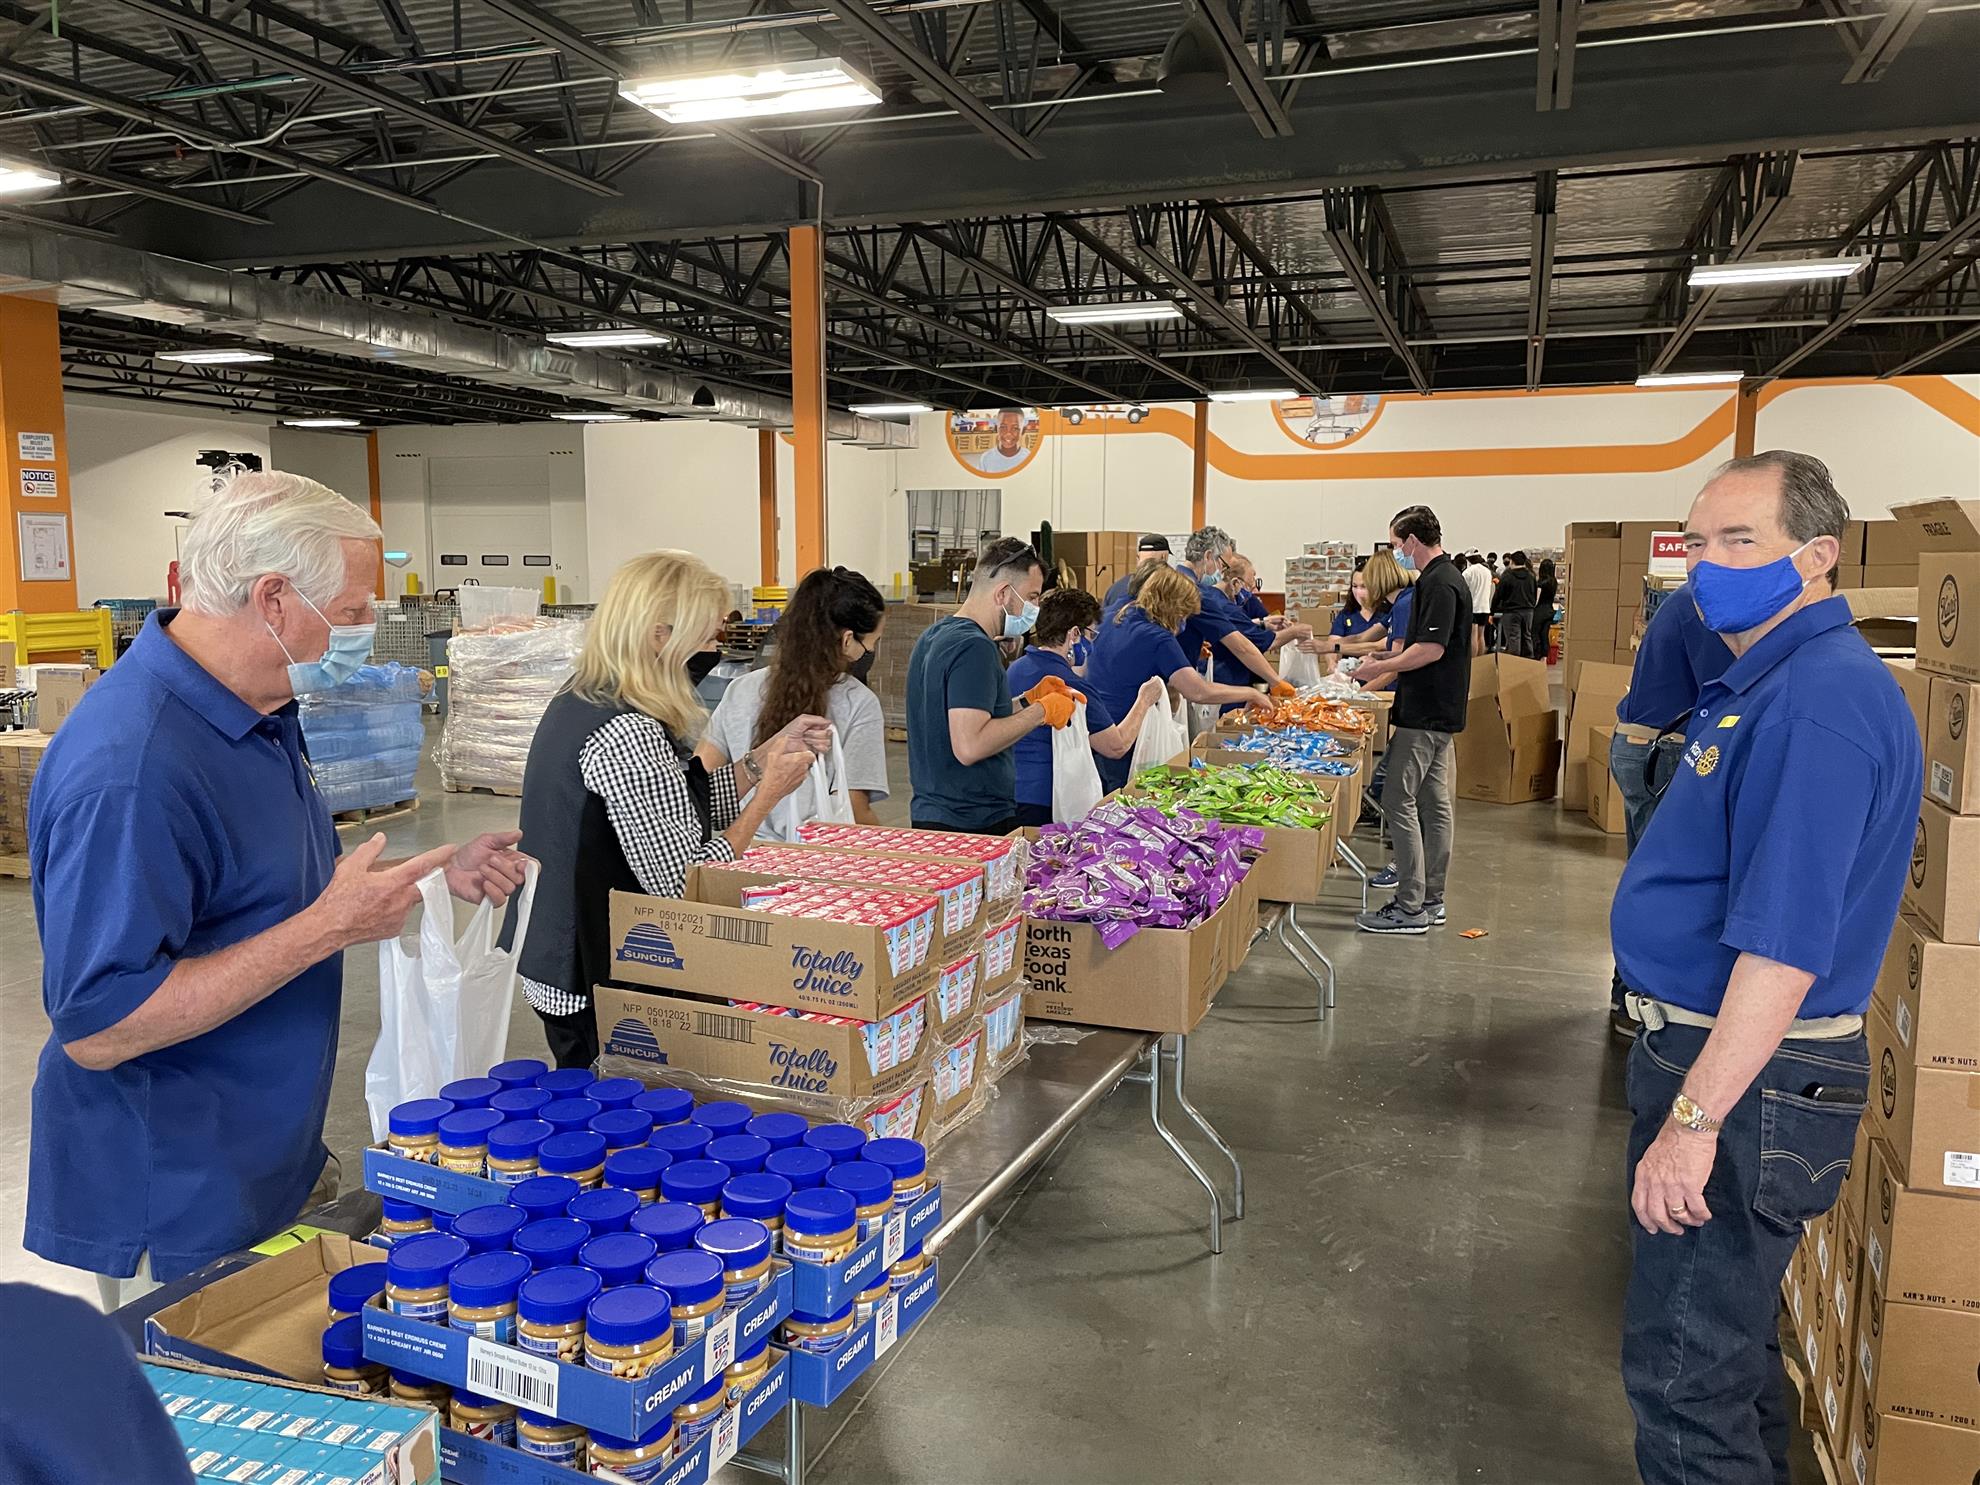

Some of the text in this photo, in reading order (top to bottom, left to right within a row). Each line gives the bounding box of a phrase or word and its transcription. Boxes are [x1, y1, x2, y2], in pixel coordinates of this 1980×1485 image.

[22, 471, 55, 481] NOTICE
[634, 906, 704, 925] NFP 05012021
[624, 949, 675, 965] SUNCUP
[791, 944, 864, 980] Totally
[793, 967, 854, 997] Juice
[624, 1003, 690, 1021] NFP 05012021
[611, 1043, 660, 1059] SUNCUP
[768, 1041, 838, 1079] Totally
[1932, 1055, 1978, 1067] KAR'S NUTS
[771, 1065, 829, 1093] Juice
[911, 1198, 940, 1228] CREAMY
[844, 1247, 877, 1284] CREAMY
[904, 1275, 935, 1309] CREAMY
[1903, 1292, 1925, 1301] KAR'S
[1927, 1294, 1946, 1304] NUTS
[743, 1299, 778, 1337] CREAMY
[391, 1330, 404, 1339] BEST
[837, 1331, 869, 1371] CREAMY
[644, 1365, 695, 1412] CREAMY
[747, 1371, 785, 1416] CREAMY
[1891, 1405, 1913, 1415] KAR'S
[1915, 1408, 1935, 1419] NUTS
